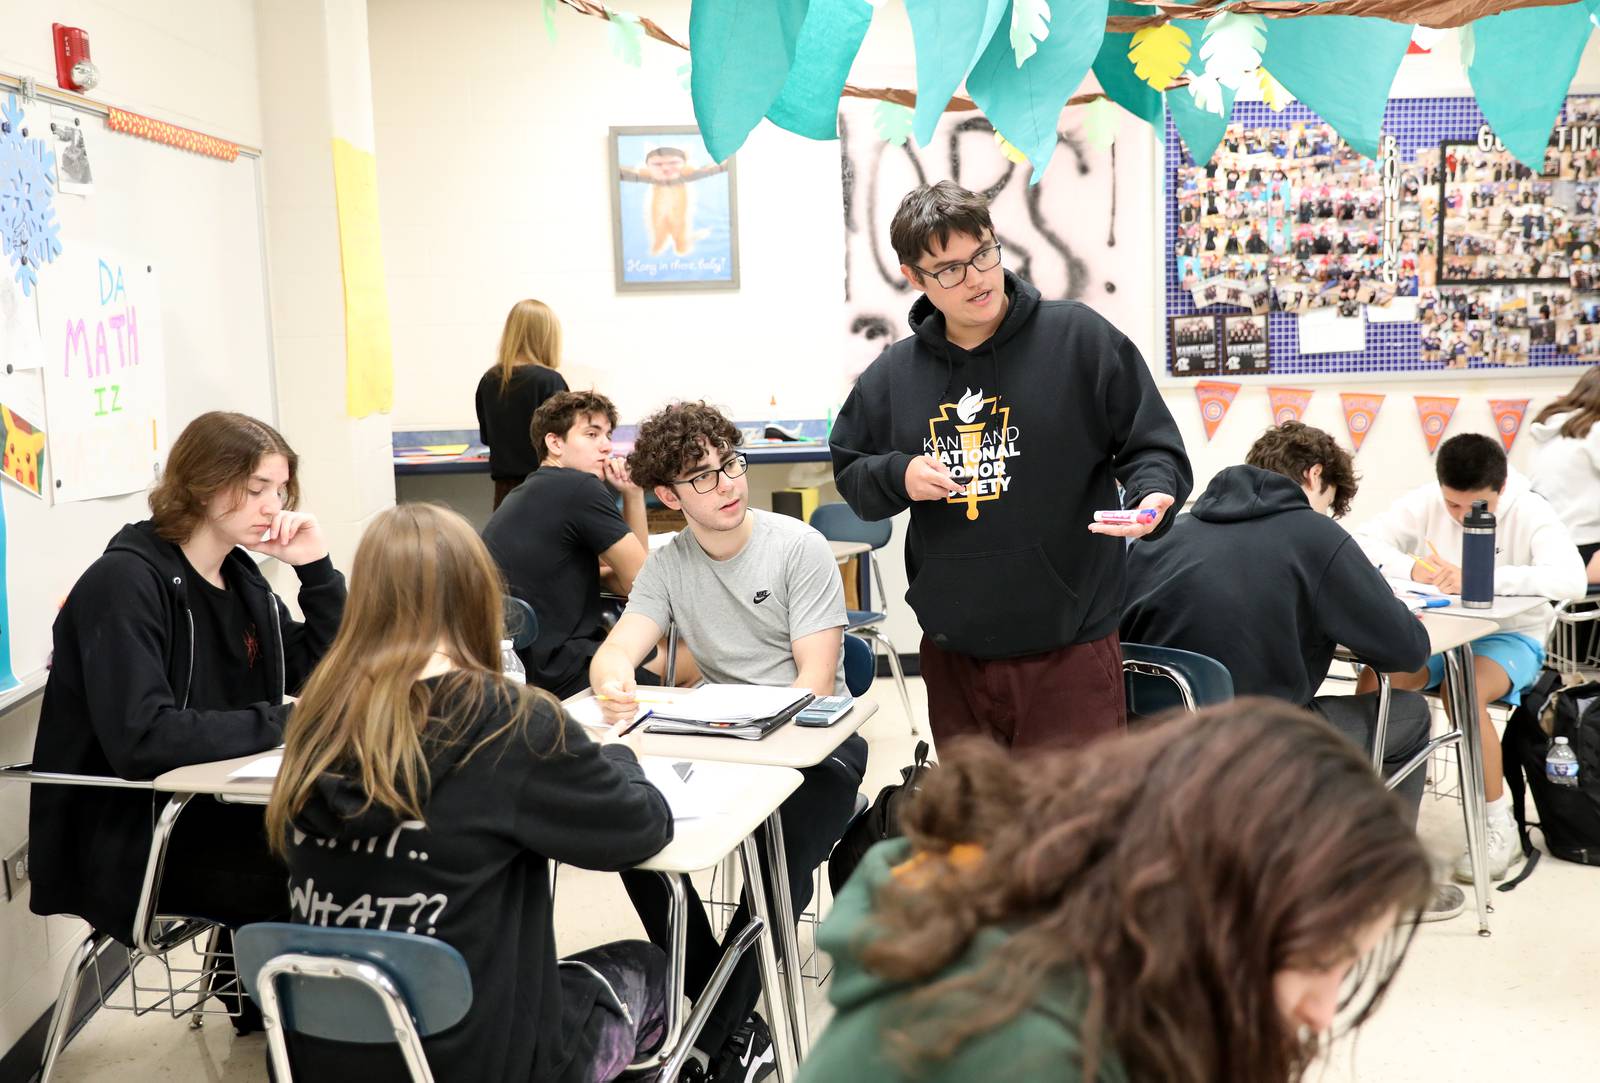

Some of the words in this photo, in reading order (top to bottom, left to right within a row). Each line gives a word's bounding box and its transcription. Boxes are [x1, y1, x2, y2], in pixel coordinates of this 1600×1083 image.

[1555, 125, 1600, 152] TIM
[1383, 135, 1400, 285] BOWLING
[659, 260, 669, 271] in
[98, 258, 127, 306] DA
[64, 304, 139, 379] MATH
[94, 384, 123, 416] IZ
[923, 426, 1020, 452] KANELAND
[947, 460, 1007, 479] ONOR
[288, 877, 448, 935] WHAT??
